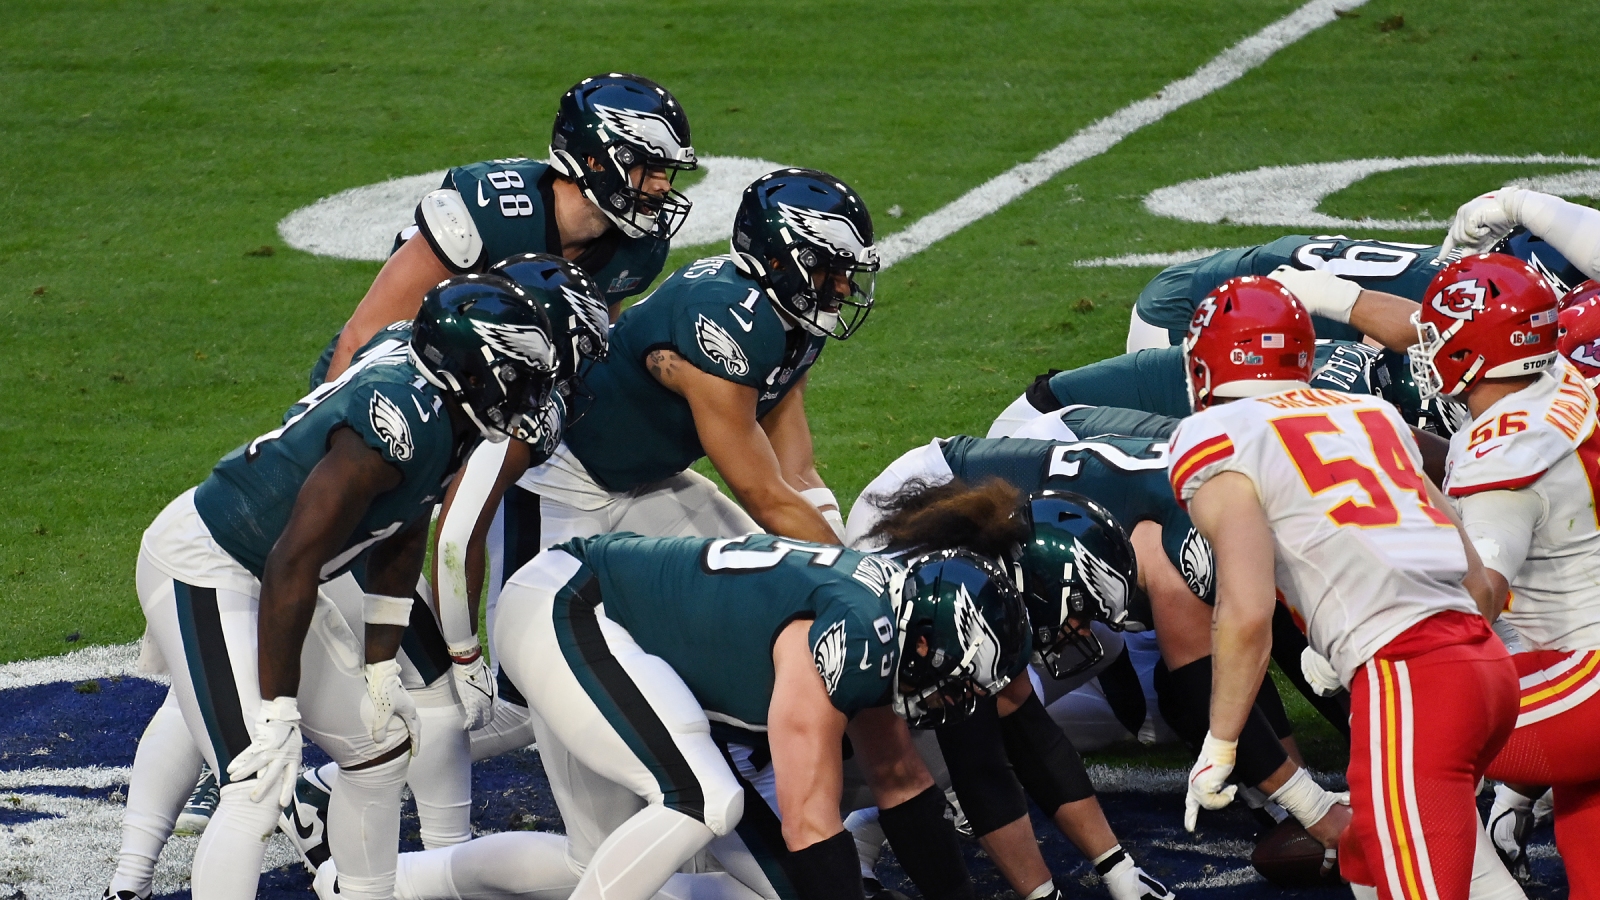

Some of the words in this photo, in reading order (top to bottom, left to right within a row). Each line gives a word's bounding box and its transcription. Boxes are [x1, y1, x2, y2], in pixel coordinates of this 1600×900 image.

[487, 170, 533, 217] 88
[738, 287, 760, 314] 1
[1233, 351, 1243, 362] 16
[1523, 360, 1547, 370] STOP
[408, 374, 443, 419] 11
[1466, 410, 1531, 452] 56
[1267, 408, 1456, 529] 54
[873, 616, 895, 677] 65
